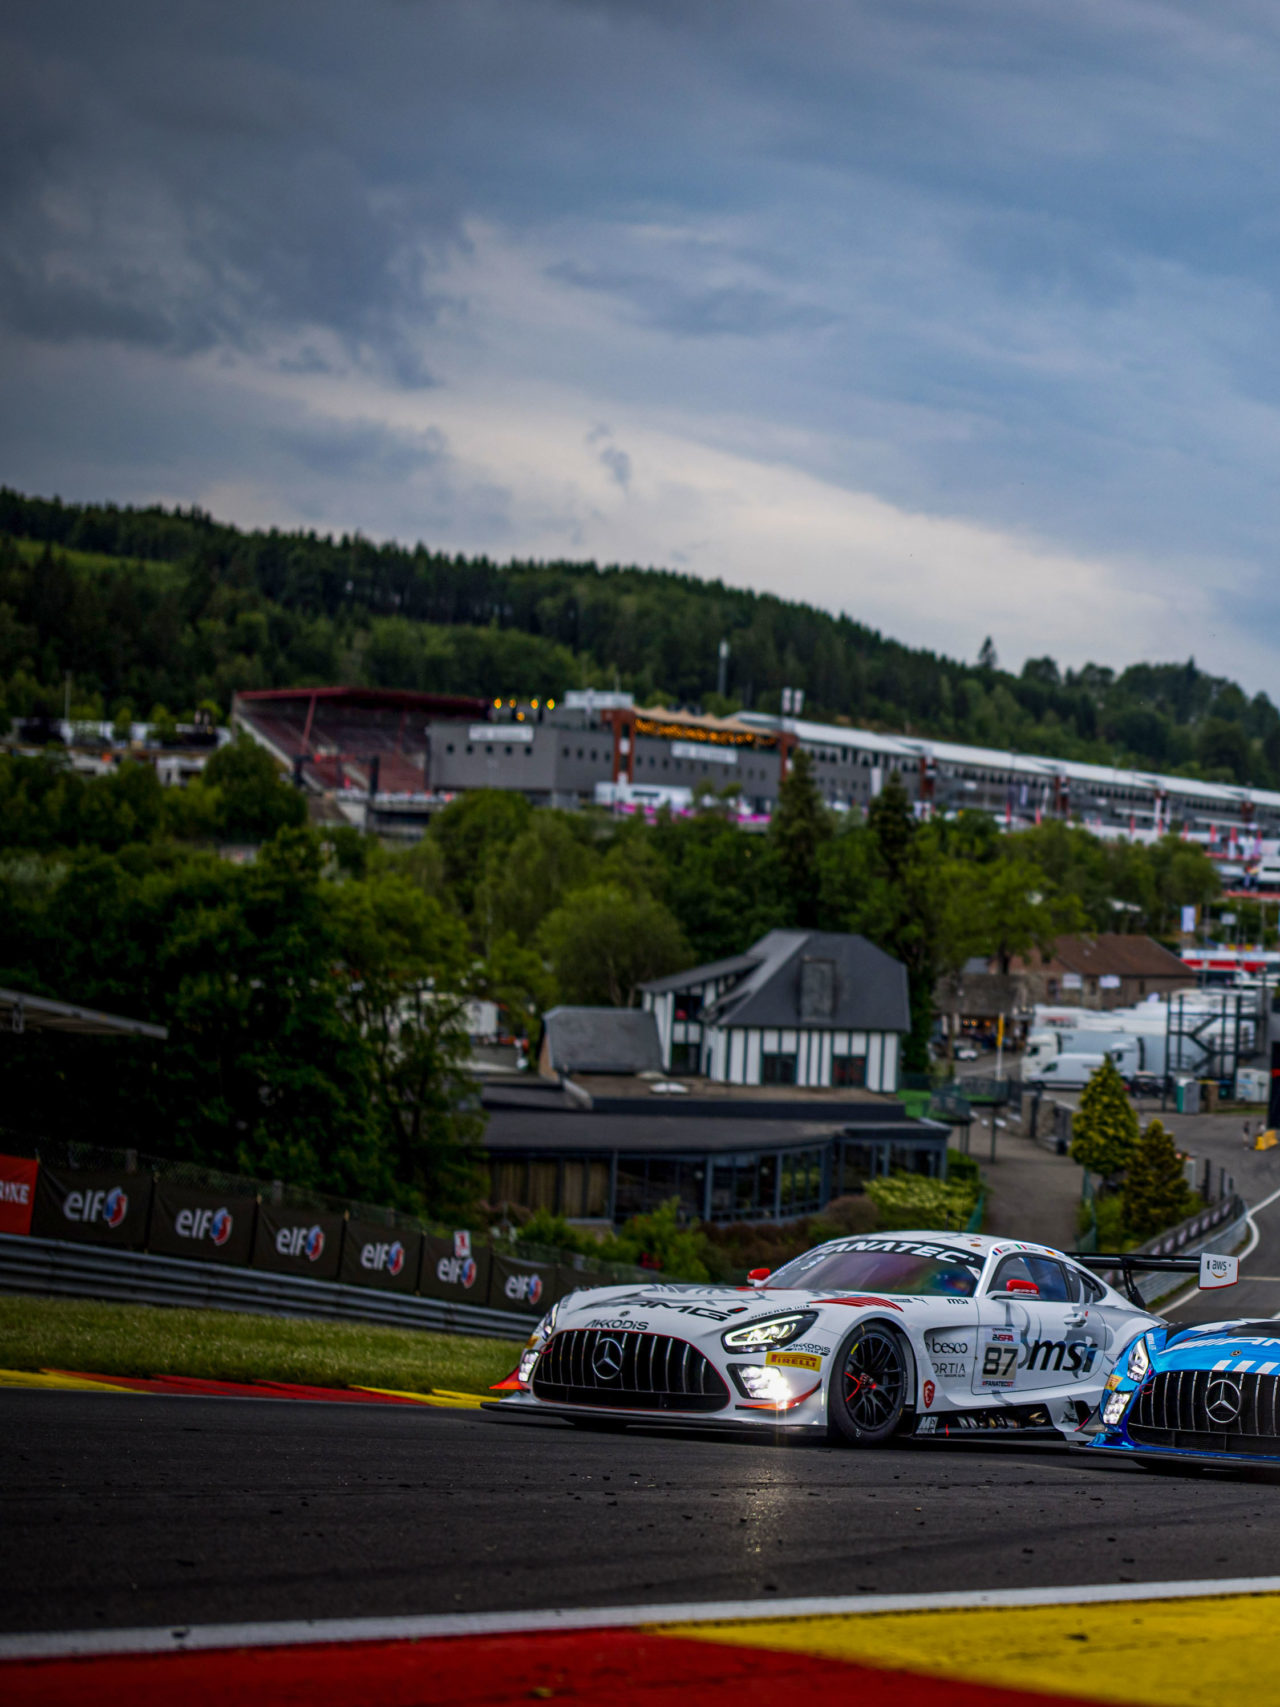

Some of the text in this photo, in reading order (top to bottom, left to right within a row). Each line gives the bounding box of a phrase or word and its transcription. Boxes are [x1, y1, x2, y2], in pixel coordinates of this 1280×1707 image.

[63, 1189, 105, 1222] elf
[176, 1208, 213, 1239] elf
[276, 1226, 308, 1256] elf
[806, 1241, 971, 1264] FANATEC
[361, 1242, 389, 1270] elf
[1212, 1260, 1227, 1271] aws
[437, 1258, 462, 1284] elf
[505, 1275, 529, 1300] elf
[932, 1336, 968, 1354] besco
[1026, 1340, 1098, 1373] msi
[771, 1353, 817, 1368] PIRELLI
[931, 1362, 966, 1374] ORTIA
[982, 1347, 1019, 1376] 87
